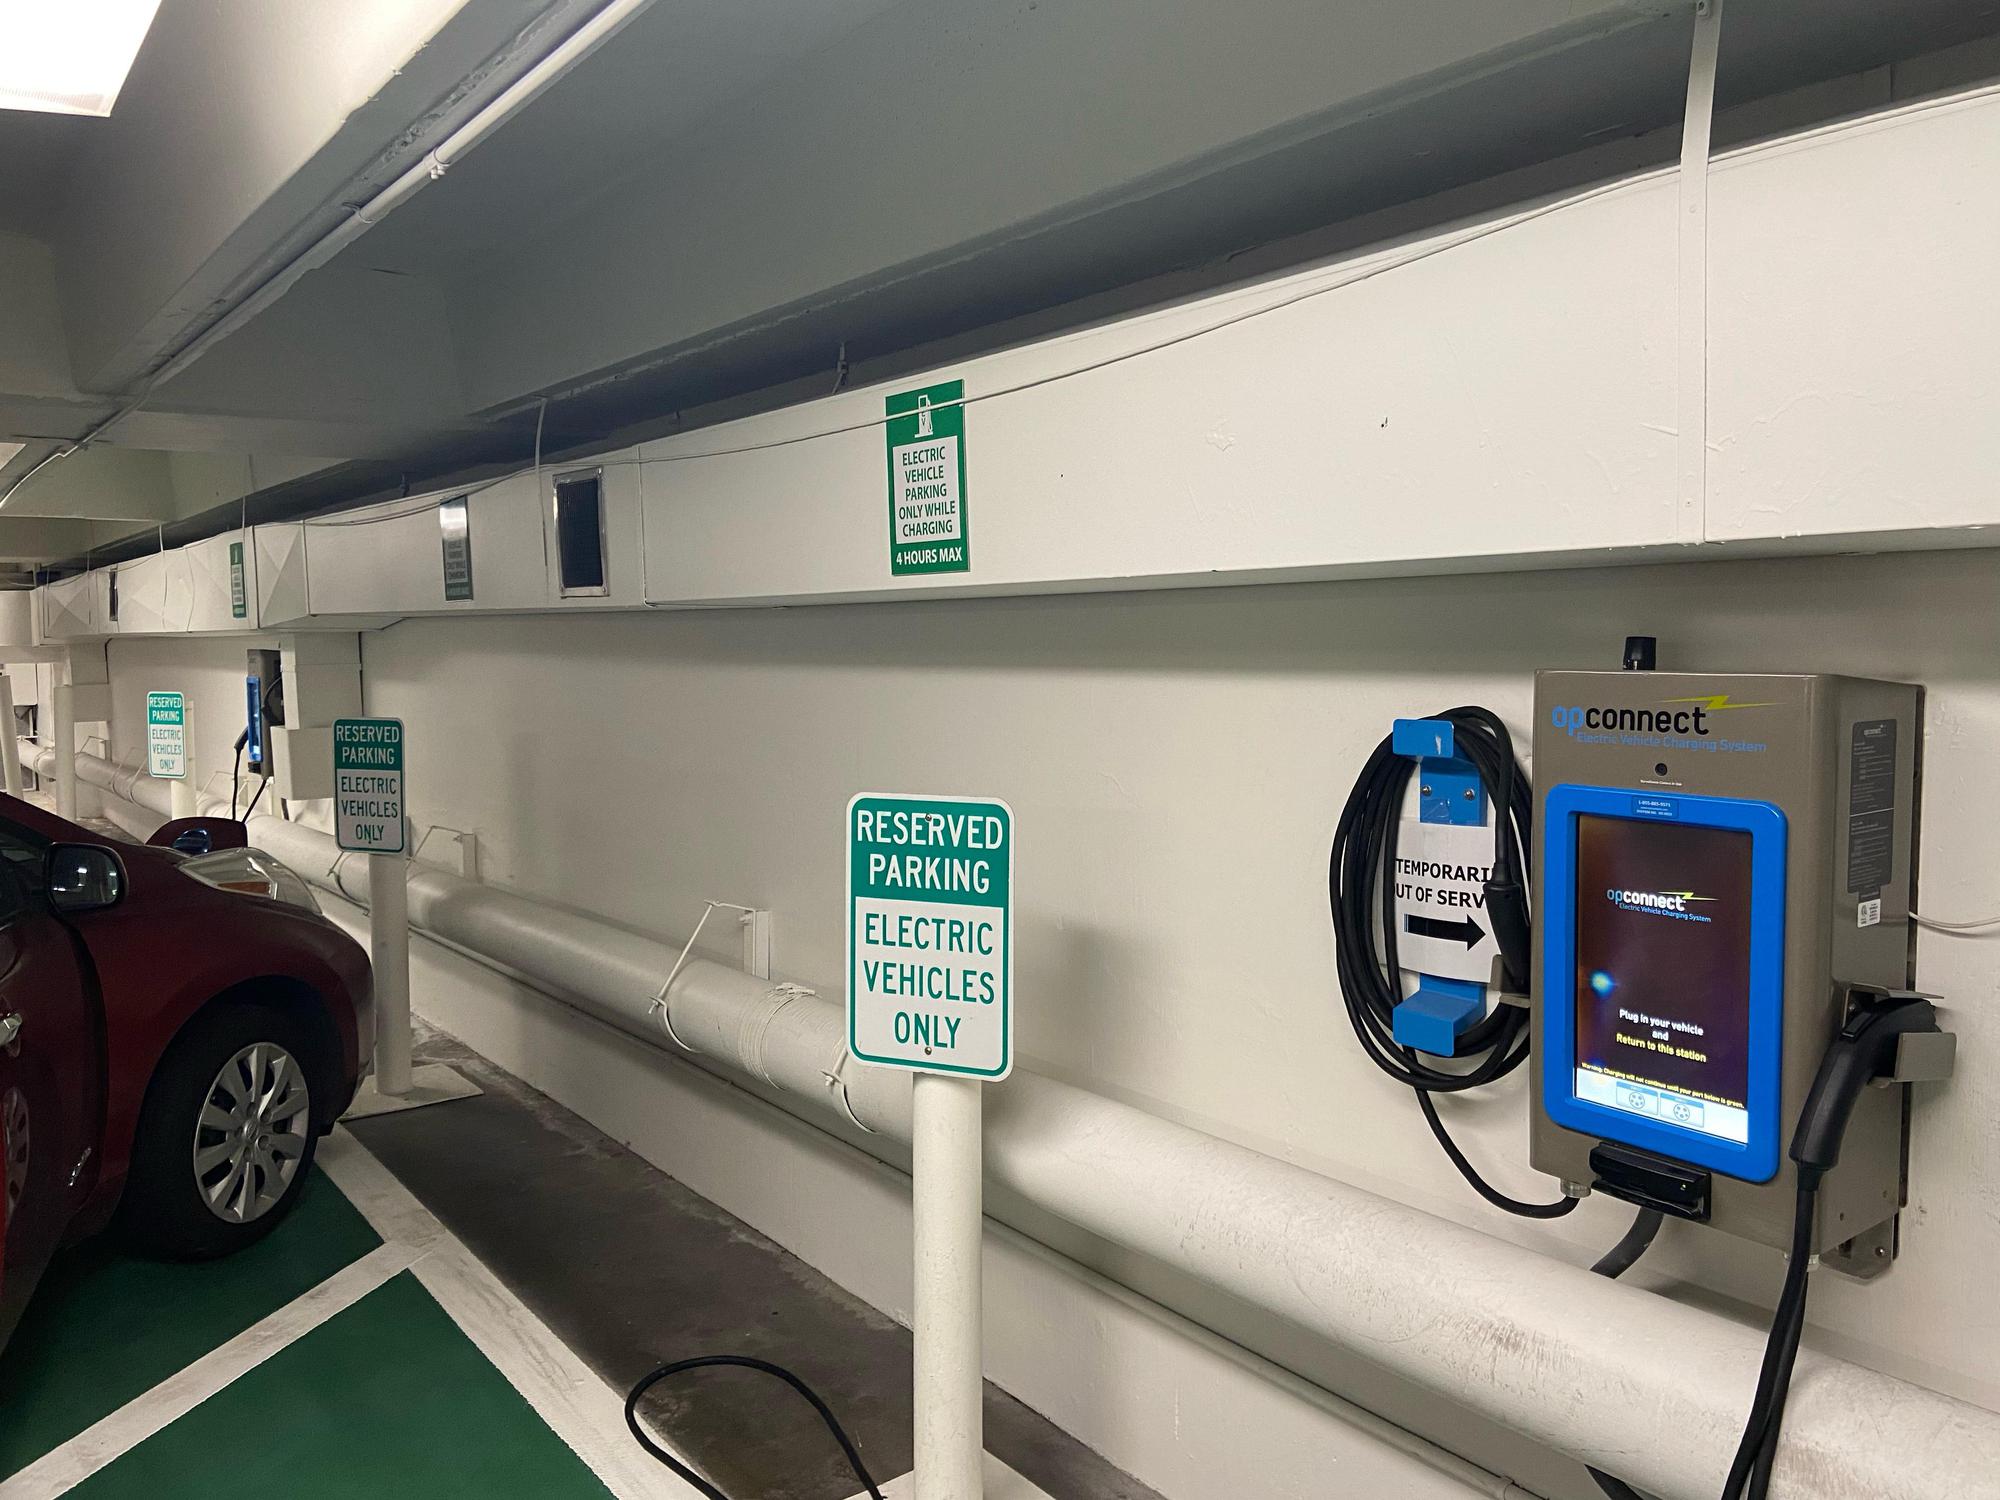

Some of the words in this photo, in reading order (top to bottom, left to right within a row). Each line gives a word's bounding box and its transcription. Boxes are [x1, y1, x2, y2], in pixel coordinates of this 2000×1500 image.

[902, 446, 946, 467] ELECTRIC
[904, 465, 944, 484] VEHICLE
[905, 483, 947, 502] PARKING
[899, 504, 923, 520] ONLY
[924, 500, 956, 517] WHILE
[902, 519, 953, 537] CHARGING
[896, 552, 902, 565] 4
[904, 549, 937, 565] HOURS
[939, 547, 962, 562] MAX
[149, 697, 182, 708] RESERVED
[152, 710, 179, 721] PARKING
[1551, 705, 1709, 736] opconnect
[152, 729, 181, 740] ELECTRIC
[336, 725, 400, 743] RESERVED
[1577, 732, 1617, 745] Electric
[1619, 734, 1661, 747] Vehicle
[1663, 736, 1717, 752] Charging
[1719, 739, 1767, 753] System
[152, 744, 182, 755] VEHICLES
[342, 747, 395, 764] PARKING
[160, 759, 175, 770] ONLY
[341, 776, 397, 794] ELECTRIC
[341, 800, 398, 818] VEHICLES
[355, 824, 385, 841] ONLY
[857, 809, 1003, 850] RESERVED
[869, 854, 990, 894] PARKING
[1396, 858, 1490, 882] TEMPORARI
[1396, 883, 1412, 899] UT
[1415, 886, 1433, 903] OF
[1437, 890, 1485, 909] SERV
[1606, 889, 1686, 911] opconnect
[1619, 903, 1640, 912] Electric
[1640, 906, 1661, 915] Vehicle
[1662, 909, 1688, 920] Charging
[1689, 913, 1712, 923] System
[865, 912, 993, 956] ELECTRIC
[863, 959, 995, 1005] VEHICLES
[894, 1011, 961, 1049] ONLY
[1619, 1008, 1639, 1023] Plug
[1640, 1013, 1648, 1024] in
[1650, 1017, 1670, 1028] your
[1671, 1021, 1704, 1036] vehicle
[1652, 1030, 1669, 1041] and
[1616, 1033, 1646, 1048] Return
[1647, 1041, 1656, 1051] to
[1657, 1043, 1674, 1055] this
[1675, 1048, 1707, 1062] station
